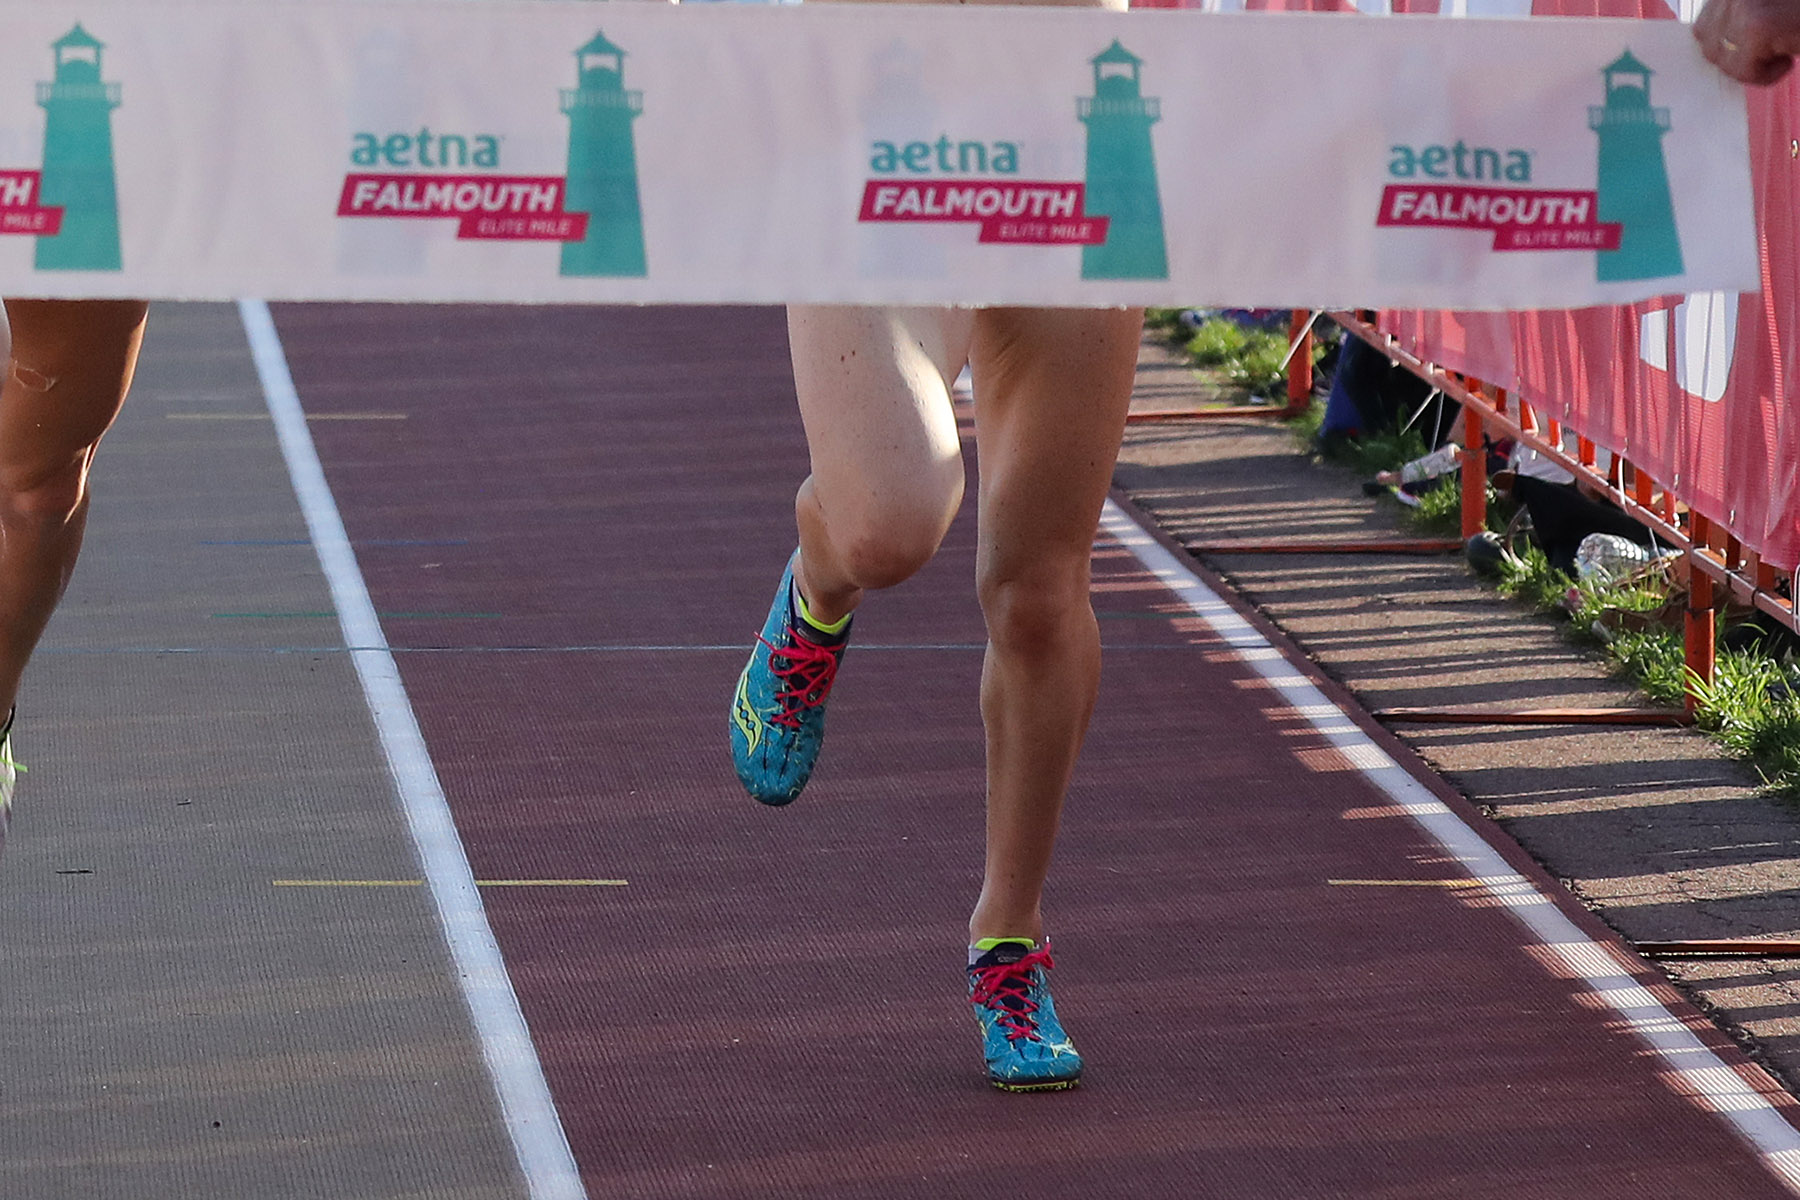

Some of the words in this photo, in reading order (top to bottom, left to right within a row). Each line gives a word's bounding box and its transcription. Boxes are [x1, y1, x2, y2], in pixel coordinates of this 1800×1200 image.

[351, 127, 499, 167] aetna
[870, 134, 1019, 174] aetna
[1389, 140, 1532, 182] aetna
[351, 181, 557, 212] FALMOUTH
[872, 186, 1077, 217] FALMOUTH
[1391, 192, 1590, 225] FALMOUTH
[3, 212, 46, 229] MILE
[528, 219, 571, 235] MILE
[1051, 224, 1092, 239] MILE
[1564, 230, 1605, 246] MILE
